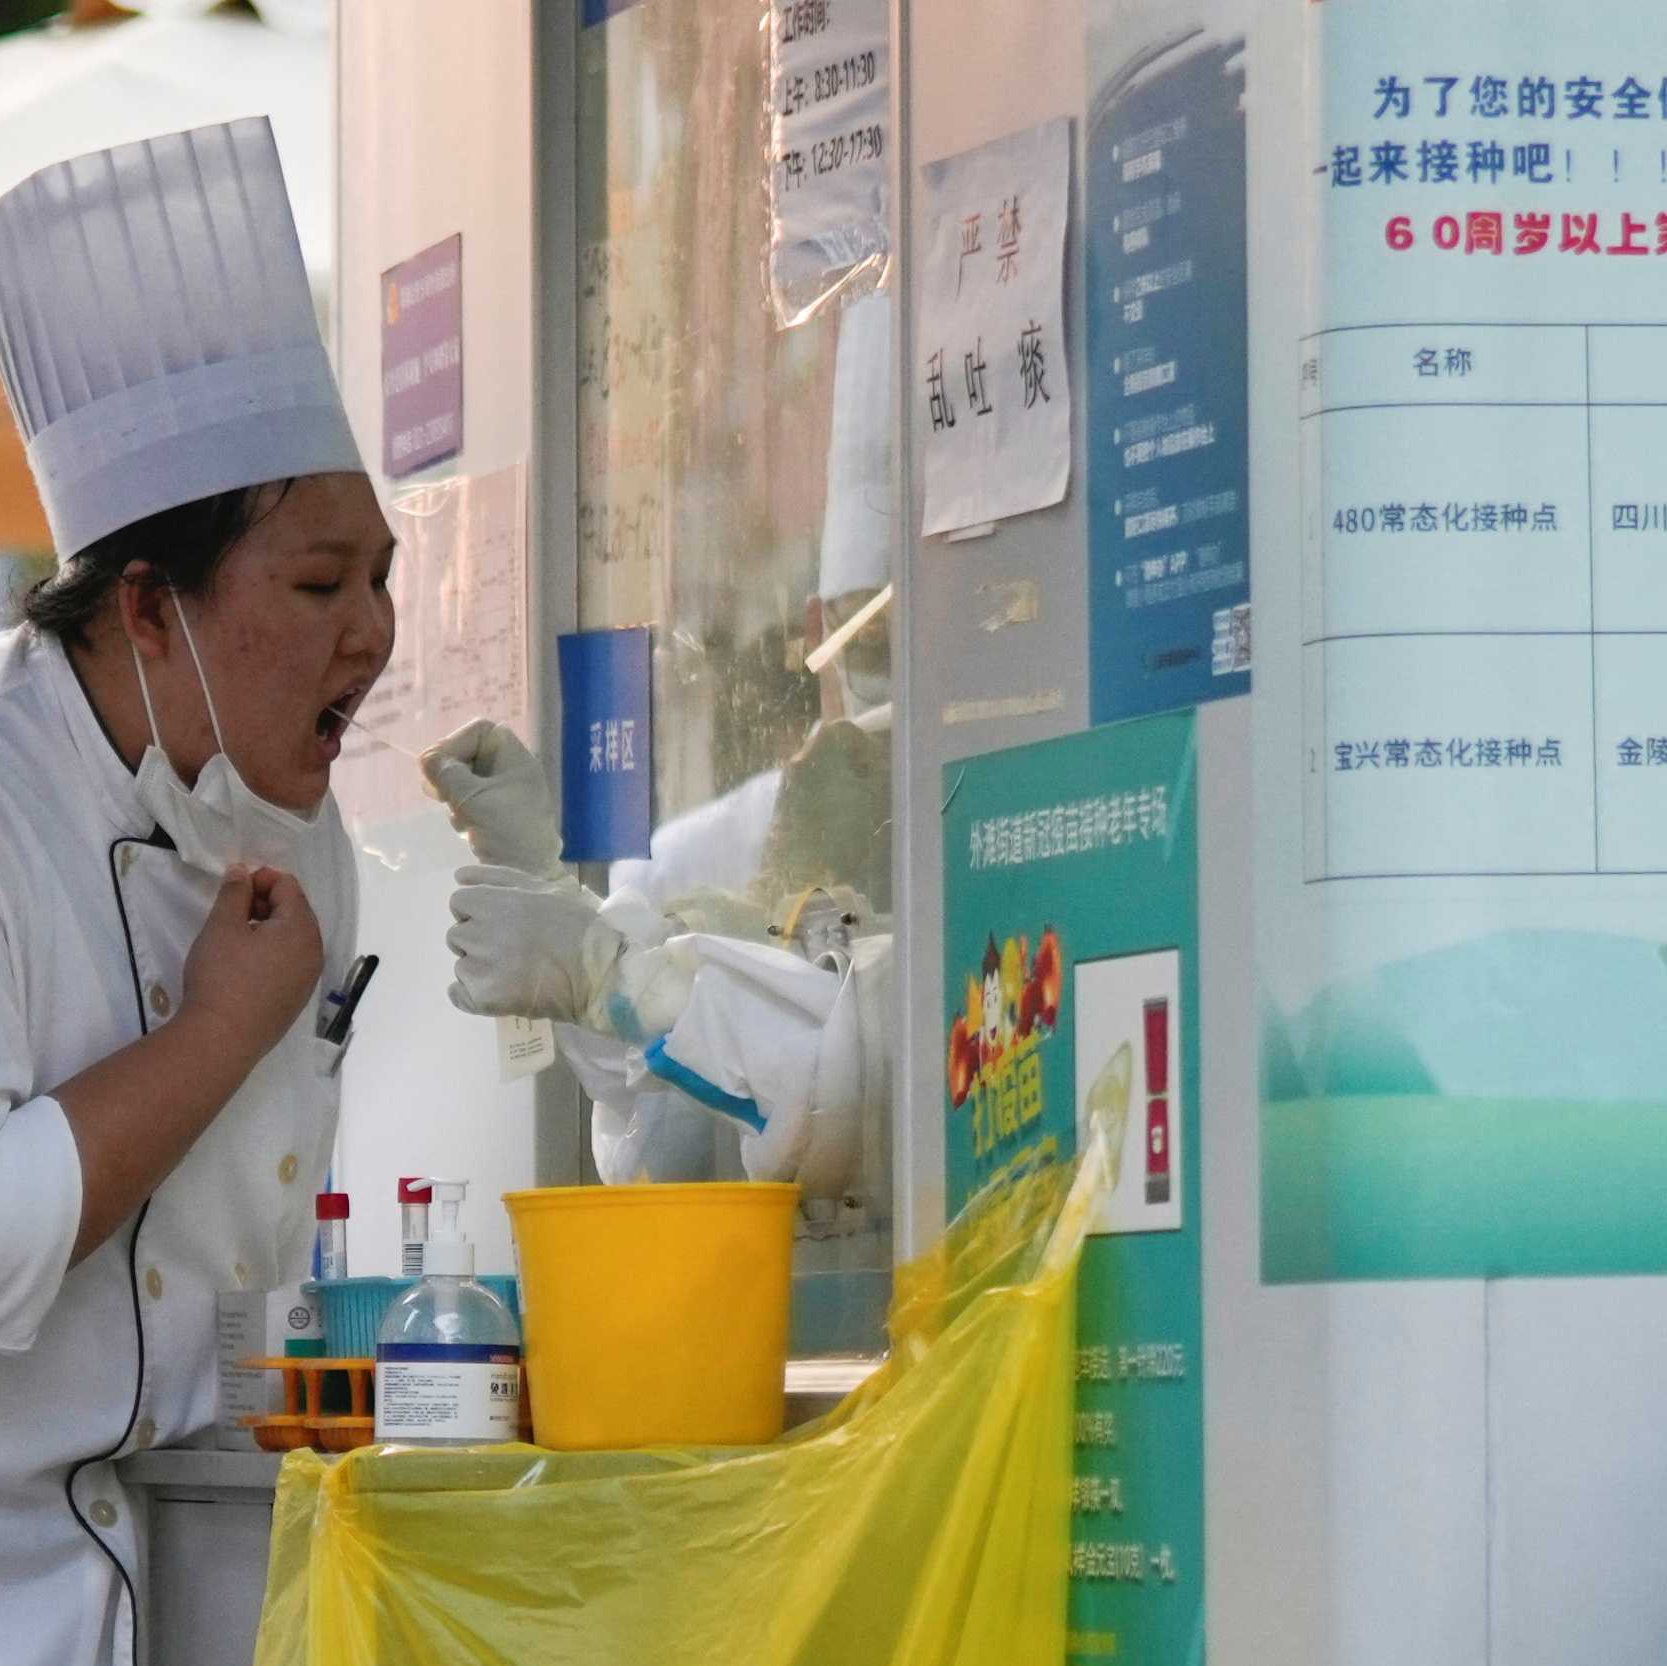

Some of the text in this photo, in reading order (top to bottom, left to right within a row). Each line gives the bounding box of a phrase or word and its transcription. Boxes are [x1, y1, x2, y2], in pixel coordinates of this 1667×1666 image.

[956, 195, 1022, 302] 严禁
[927, 319, 1050, 432] 乱吐痰
[1413, 347, 1473, 378] 名称
[1332, 502, 1558, 535] 480常态化接种点
[1611, 503, 1667, 533] 四川
[589, 720, 635, 773] 采样区
[1334, 737, 1562, 771] 宝兴常态化接种点
